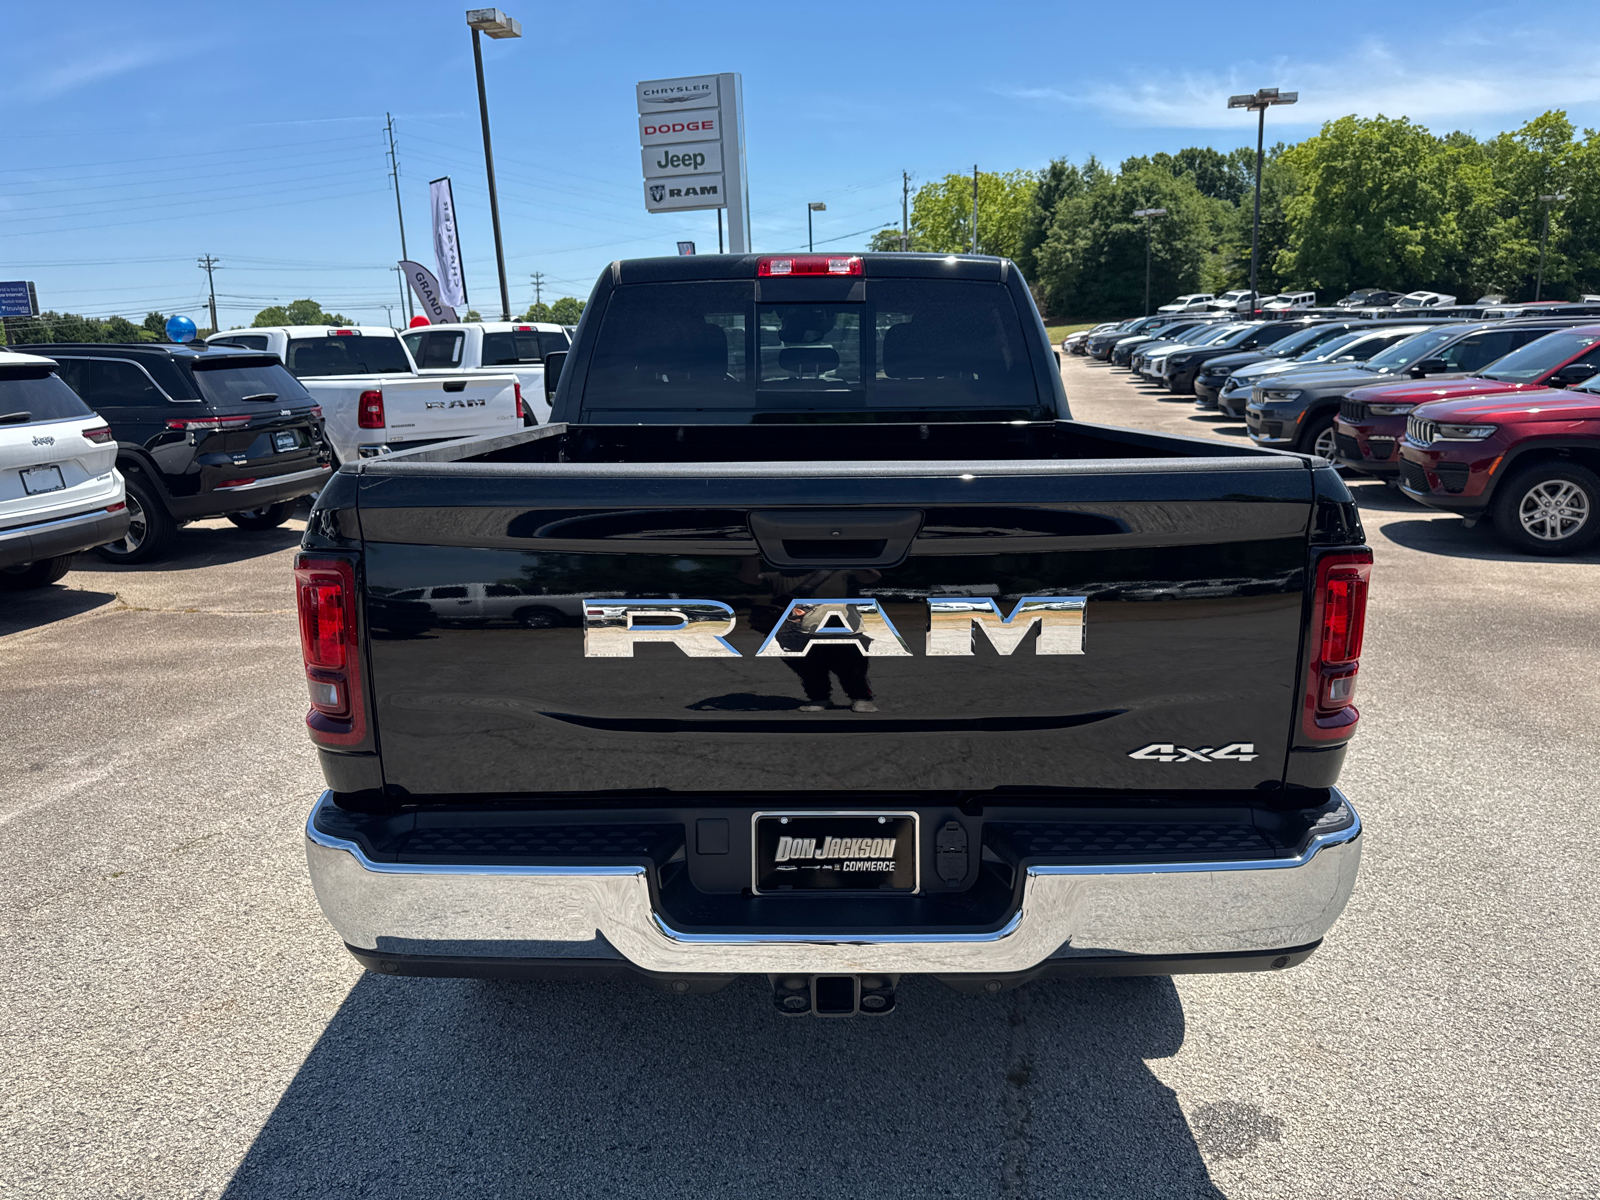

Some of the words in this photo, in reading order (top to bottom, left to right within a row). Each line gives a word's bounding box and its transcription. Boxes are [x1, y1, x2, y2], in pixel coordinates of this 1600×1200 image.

[643, 84, 709, 96] CHRYSLER
[644, 120, 714, 136] DODGE
[657, 150, 705, 170] Jeep
[669, 185, 718, 198] RAM
[415, 272, 443, 316] GRAND
[425, 399, 486, 410] RAM
[32, 435, 55, 446] Jeep
[582, 596, 1088, 658] RAM
[1127, 742, 1260, 763] 4x4
[775, 836, 816, 862] DON
[815, 835, 896, 860] JACKSON
[843, 861, 896, 872] COMMERCE
